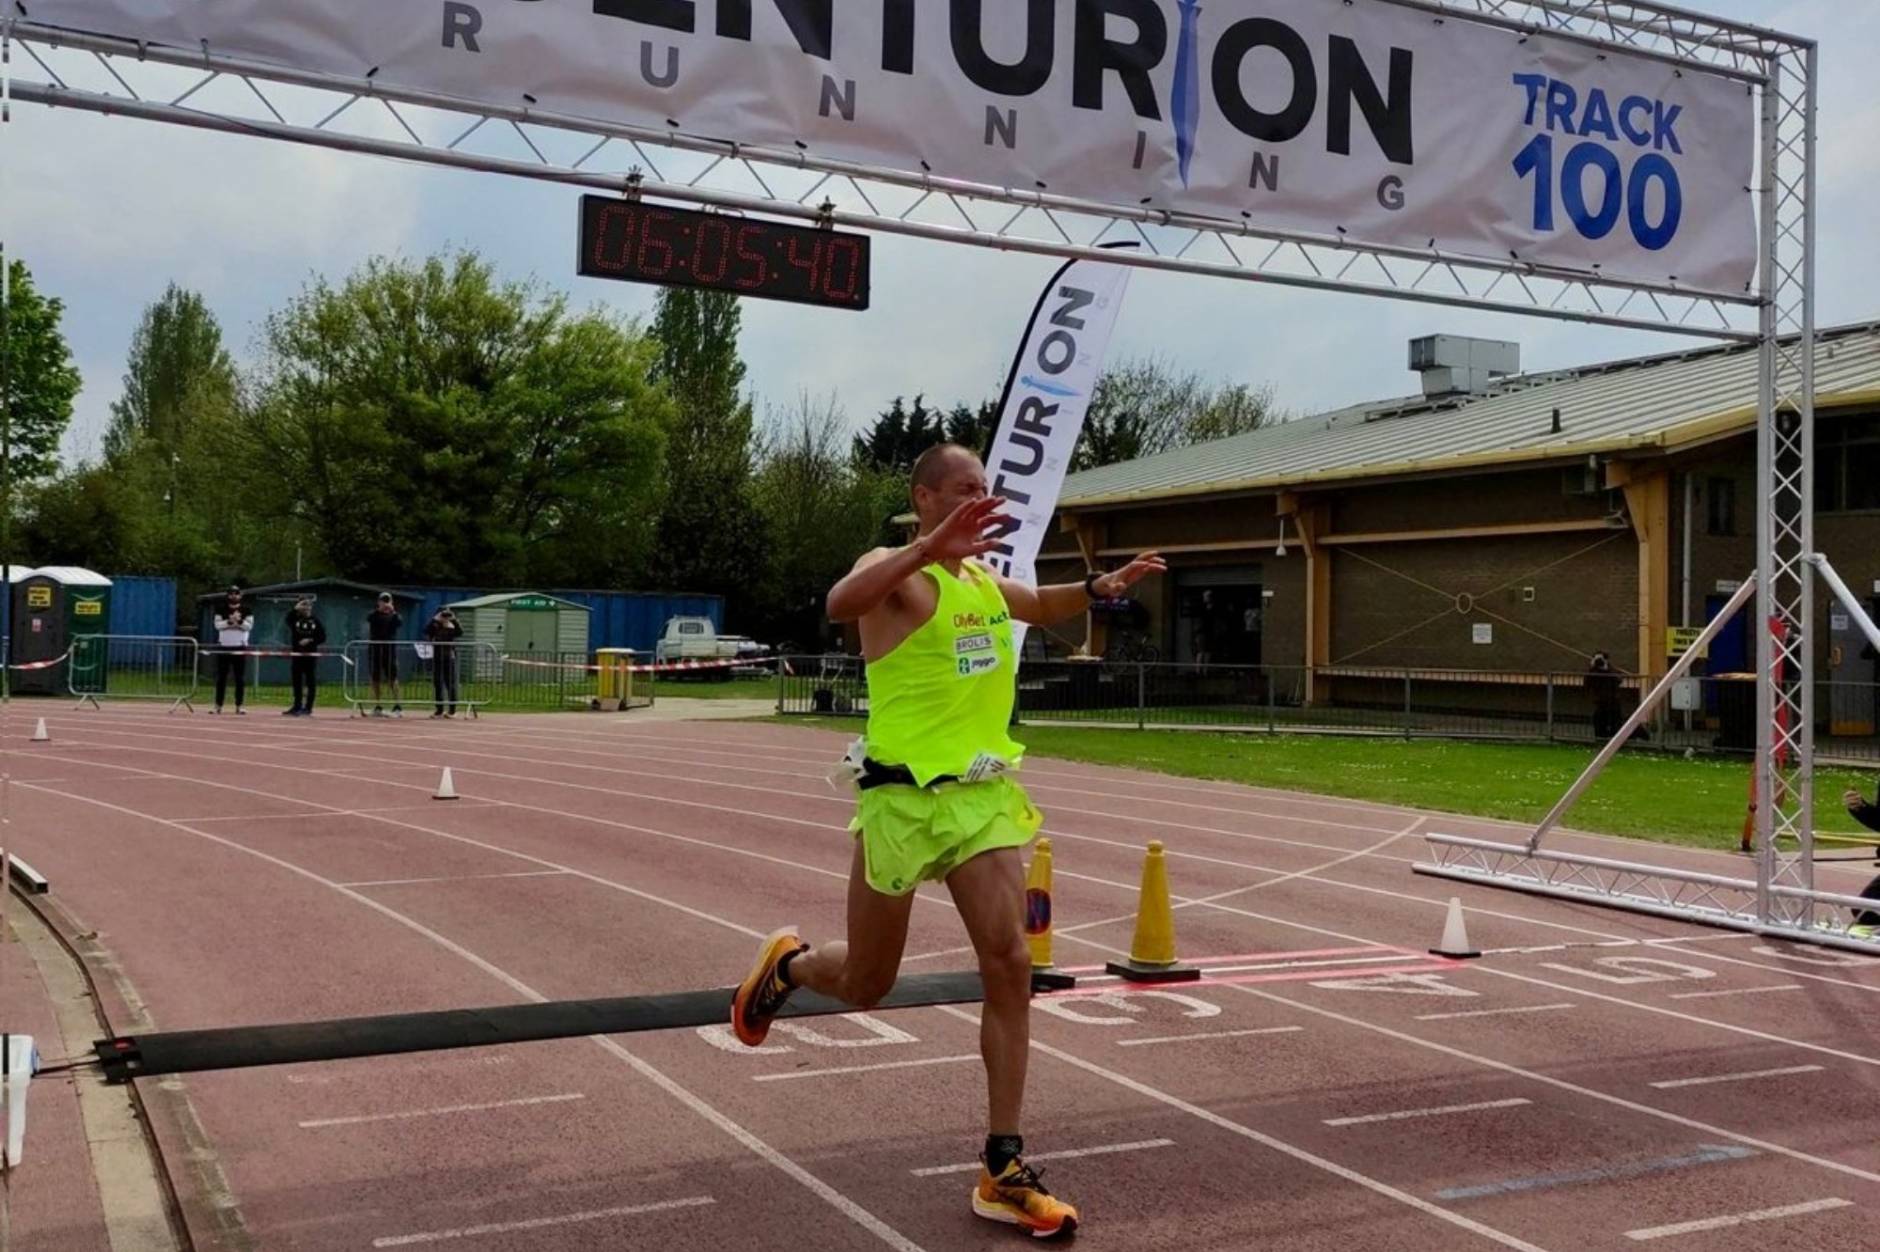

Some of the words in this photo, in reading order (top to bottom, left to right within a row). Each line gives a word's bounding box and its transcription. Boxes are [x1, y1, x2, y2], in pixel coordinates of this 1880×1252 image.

[500, 0, 1413, 190] URION
[1512, 73, 1682, 155] TRACK
[1511, 133, 1682, 250] 100
[593, 204, 860, 299] 06:05:40
